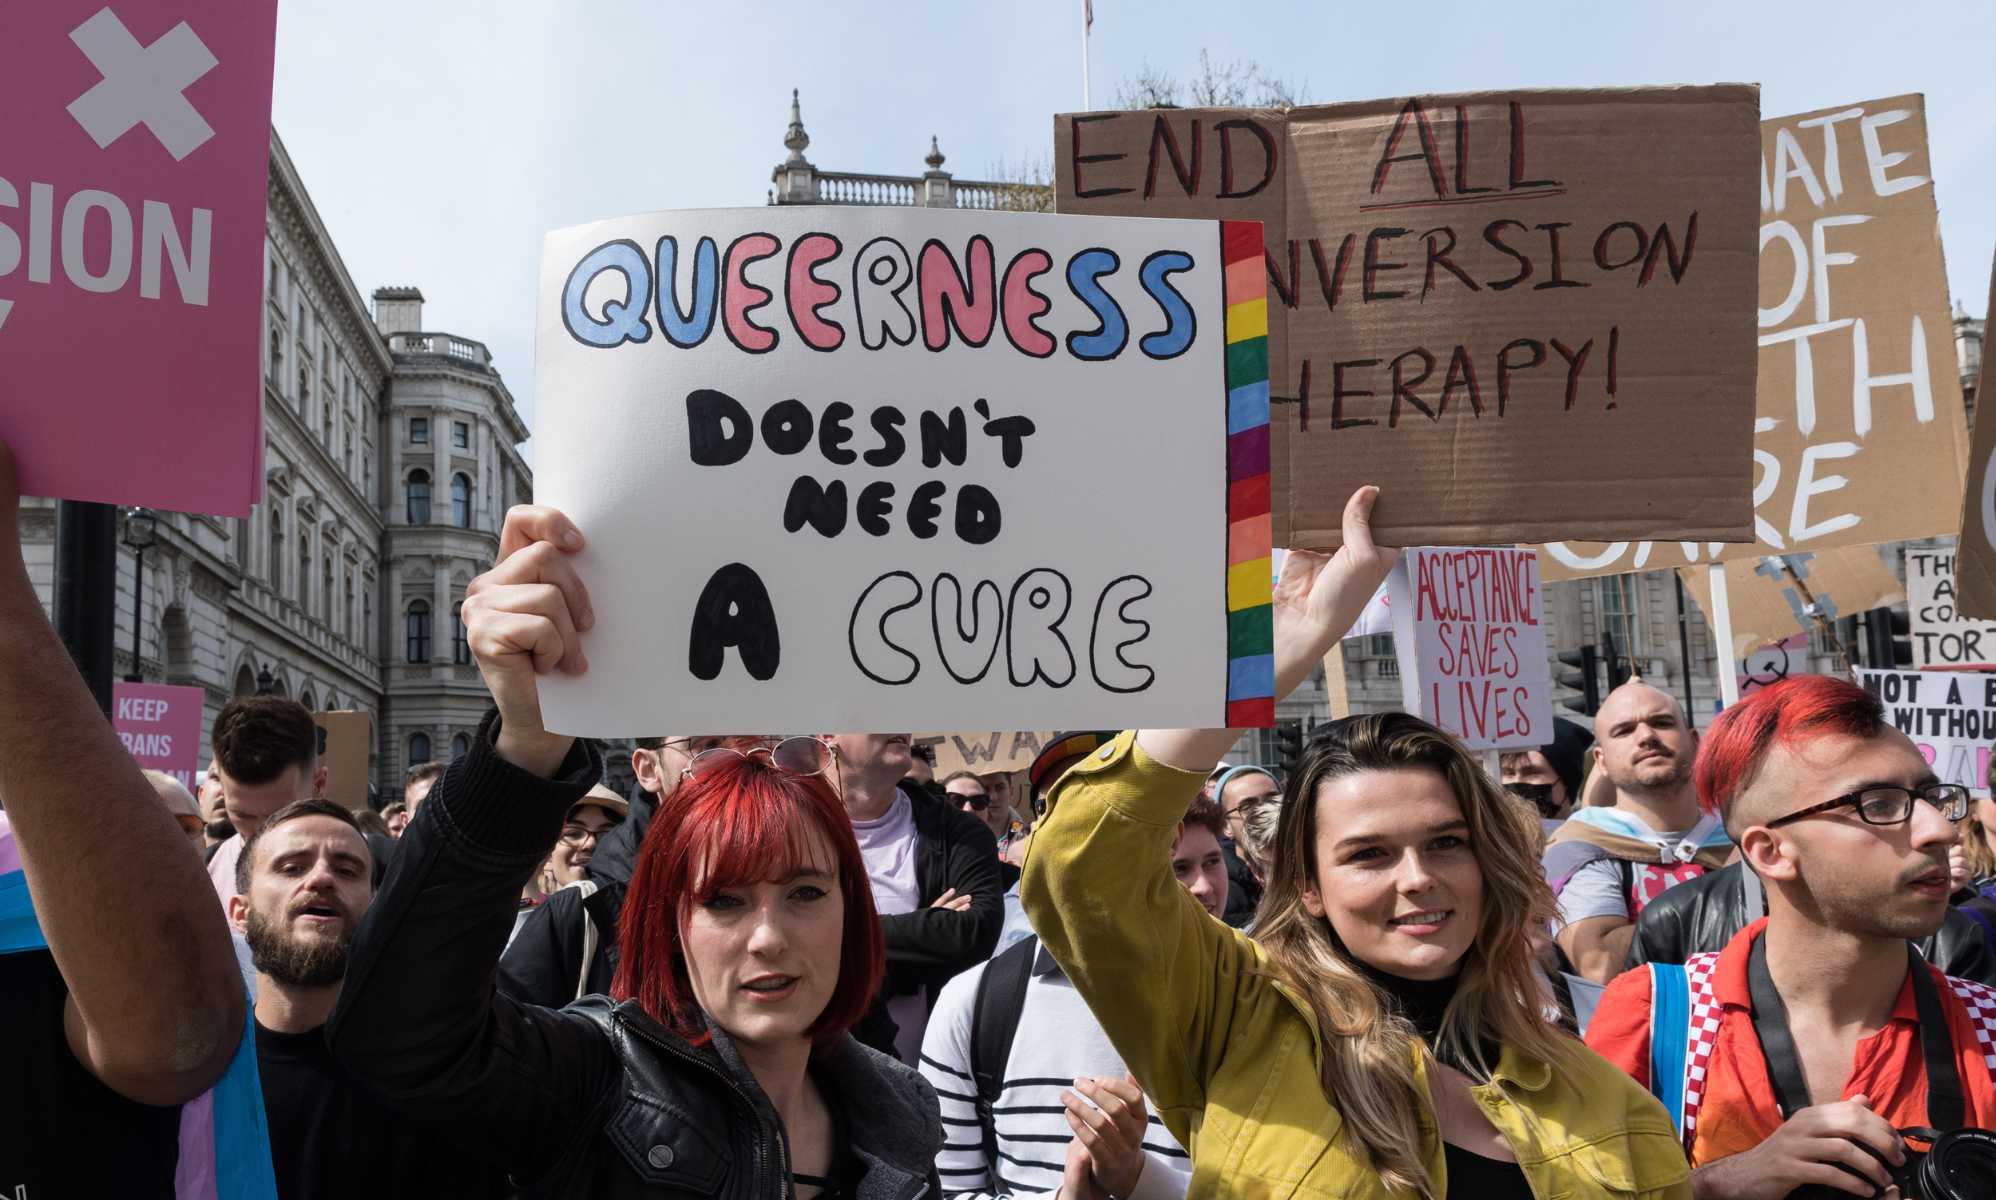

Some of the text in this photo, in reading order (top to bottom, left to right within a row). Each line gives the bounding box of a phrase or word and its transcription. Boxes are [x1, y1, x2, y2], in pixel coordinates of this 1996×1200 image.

[1072, 97, 1564, 200] END ALL
[1761, 108, 1933, 213] ATE
[560, 232, 1198, 361] QUEERNESS
[1266, 210, 1699, 310] NVERSION
[1758, 214, 1876, 323] OF
[1268, 326, 1619, 432] HERAPY!
[1756, 315, 1934, 438] TH
[686, 389, 1036, 468] DOESN'T
[783, 475, 1002, 544] NEED
[1416, 550, 1539, 626] ACCEPTANCE
[1920, 605, 1960, 623] CO
[689, 563, 1155, 694] A CURE
[1438, 622, 1519, 679] SAVES
[118, 697, 168, 722] KEEP
[1432, 680, 1530, 739] LIVES
[1863, 673, 1922, 703] NOT
[1946, 677, 1962, 705] A
[1894, 707, 1996, 740] WITHOU
[117, 731, 172, 757] RANS
